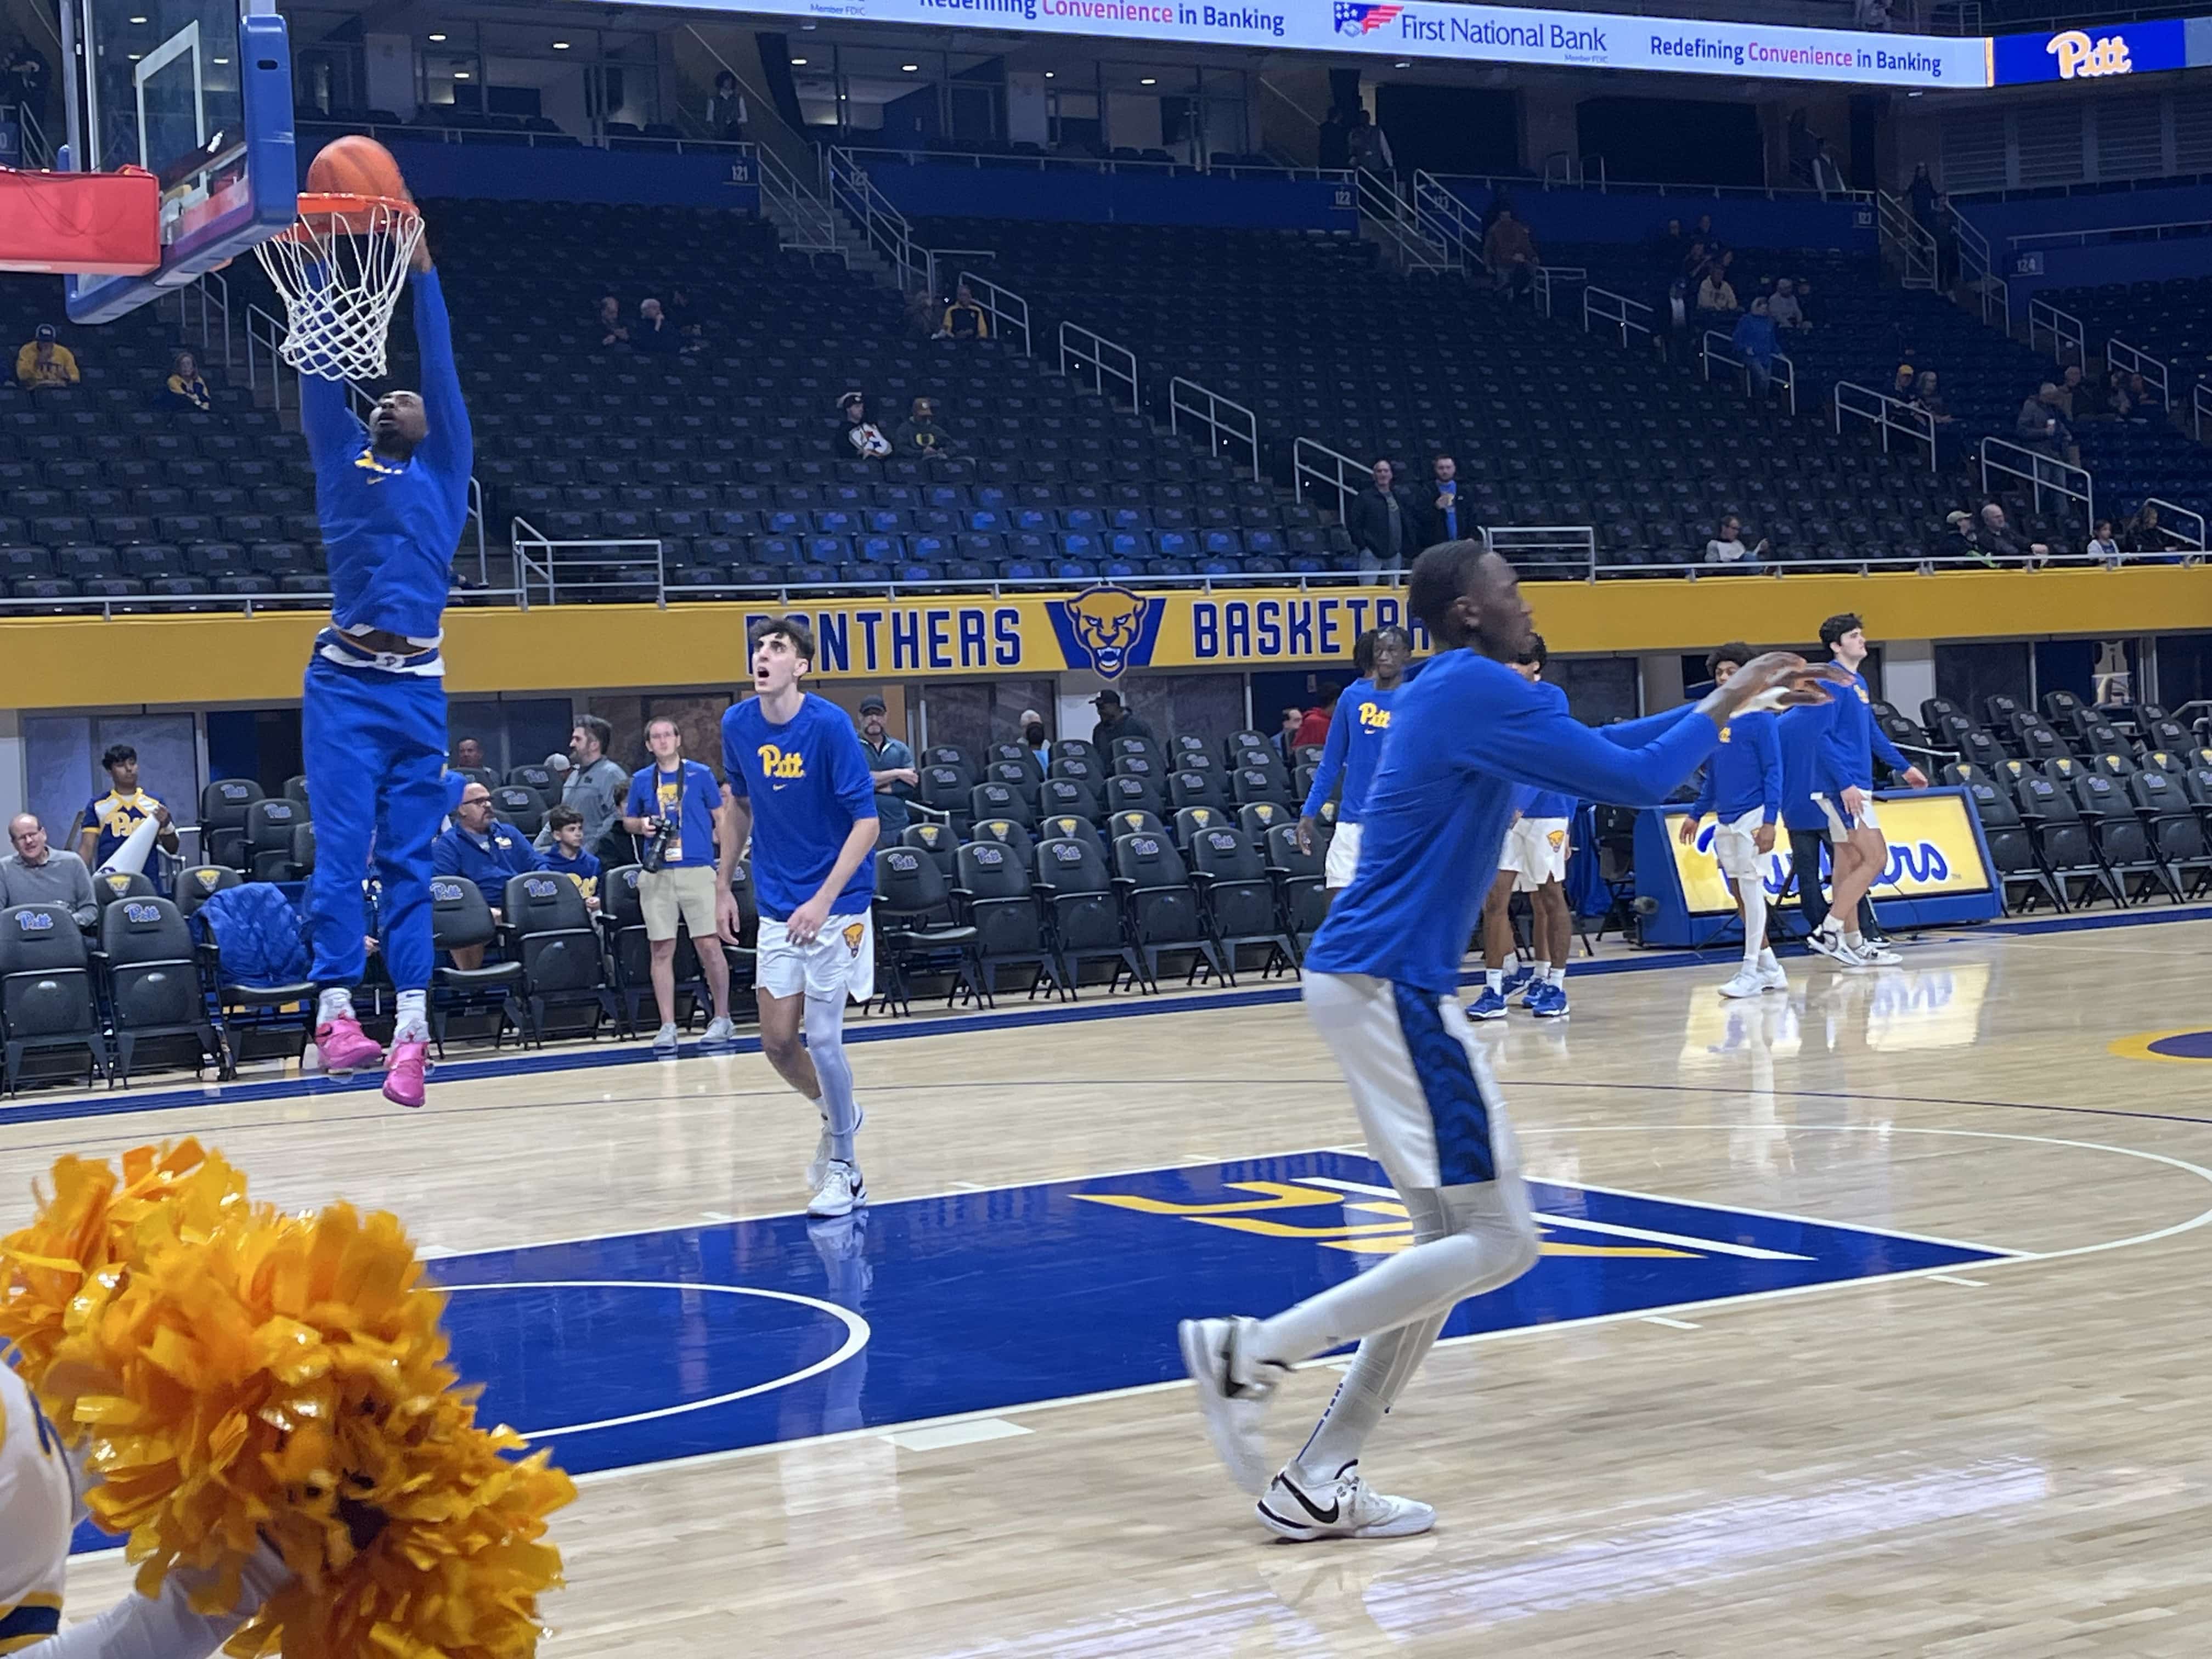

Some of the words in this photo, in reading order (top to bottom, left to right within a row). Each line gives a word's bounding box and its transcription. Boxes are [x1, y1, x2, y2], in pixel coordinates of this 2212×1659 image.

[1043, 0, 1172, 22] Convenience
[1179, 3, 1197, 25] in
[1204, 6, 1284, 37] Banking
[1402, 15, 1445, 41] First
[1451, 18, 1543, 47] National
[1550, 25, 1606, 51] Bank
[1651, 36, 1744, 65] Redefining
[1748, 42, 1853, 67] Convenience
[1857, 49, 1871, 67] in
[1877, 51, 1941, 77] Banking
[2046, 31, 2132, 78] Pitt
[732, 165, 748, 181] 121
[1336, 191, 1351, 206] 122
[745, 607, 1021, 675] NTHERS
[757, 744, 806, 778] Pitt
[430, 882, 464, 902] Pitt
[523, 879, 558, 898] Pitt
[15, 911, 54, 931] Pitt
[124, 903, 161, 923] Pitt
